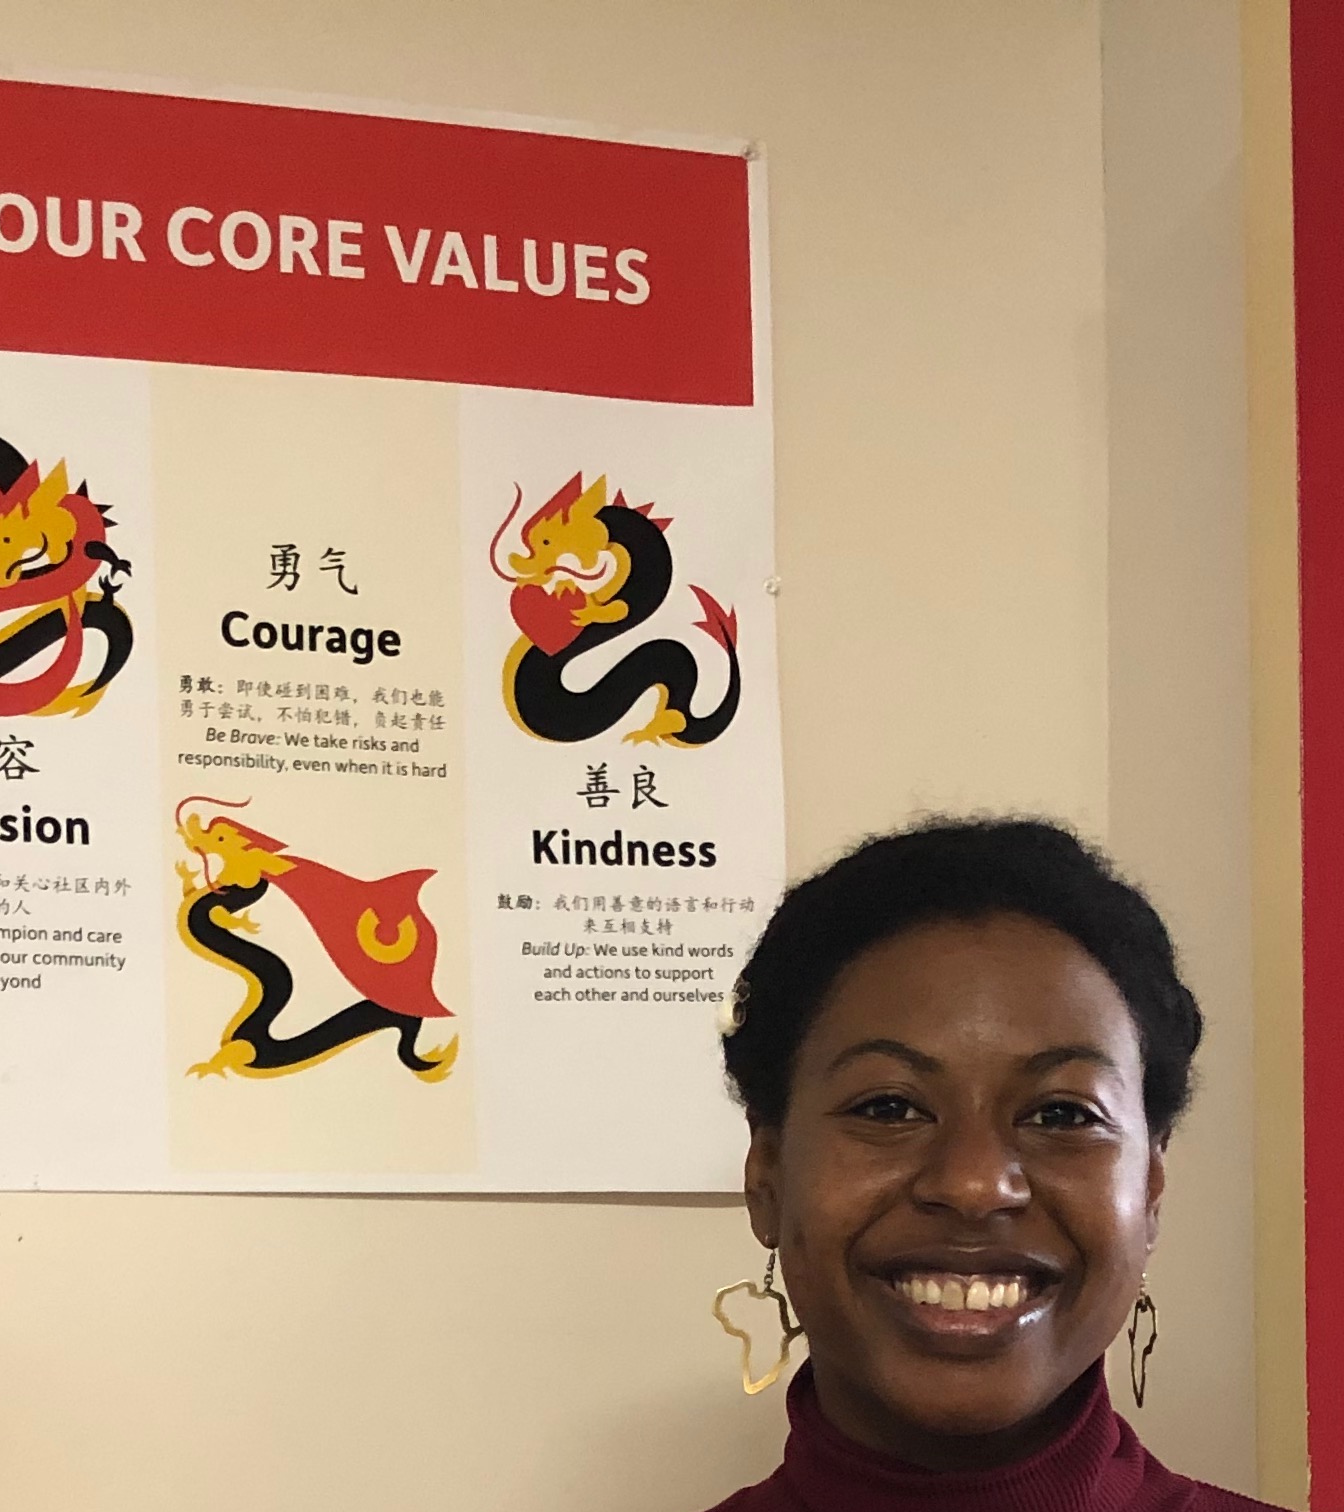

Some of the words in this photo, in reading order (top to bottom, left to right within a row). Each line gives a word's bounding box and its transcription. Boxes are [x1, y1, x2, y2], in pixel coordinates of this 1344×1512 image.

[166, 206, 366, 280] CORE
[385, 224, 652, 306] VALUES
[266, 543, 358, 595] 勇气
[221, 610, 401, 665] Courage
[205, 728, 225, 742] Be
[230, 728, 281, 746] Brave:
[284, 732, 309, 747] We
[314, 733, 348, 749] take
[352, 737, 386, 752] risks
[391, 738, 419, 753] and
[178, 752, 289, 773] responsibility,
[292, 759, 331, 772] even
[335, 760, 378, 775] when
[381, 762, 393, 775] it
[396, 763, 408, 777] is
[411, 763, 447, 778] hard
[576, 762, 669, 810] 善良
[532, 828, 717, 868] Kindness
[52, 927, 82, 942] and
[87, 931, 122, 944] care
[583, 918, 674, 936] 来互相支持
[0, 951, 27, 964] our
[32, 950, 126, 971] community
[521, 942, 560, 957] Build
[565, 943, 590, 959] Up:
[594, 943, 618, 957] We
[622, 945, 648, 957] use
[652, 943, 684, 957] kind
[688, 943, 734, 958] words
[543, 965, 572, 979] and
[575, 966, 630, 979] actions
[635, 968, 651, 979] to
[655, 967, 713, 982] support
[534, 987, 571, 1001] each
[575, 988, 616, 1002] other
[621, 988, 649, 1002] and
[653, 988, 724, 1002] ourselves
